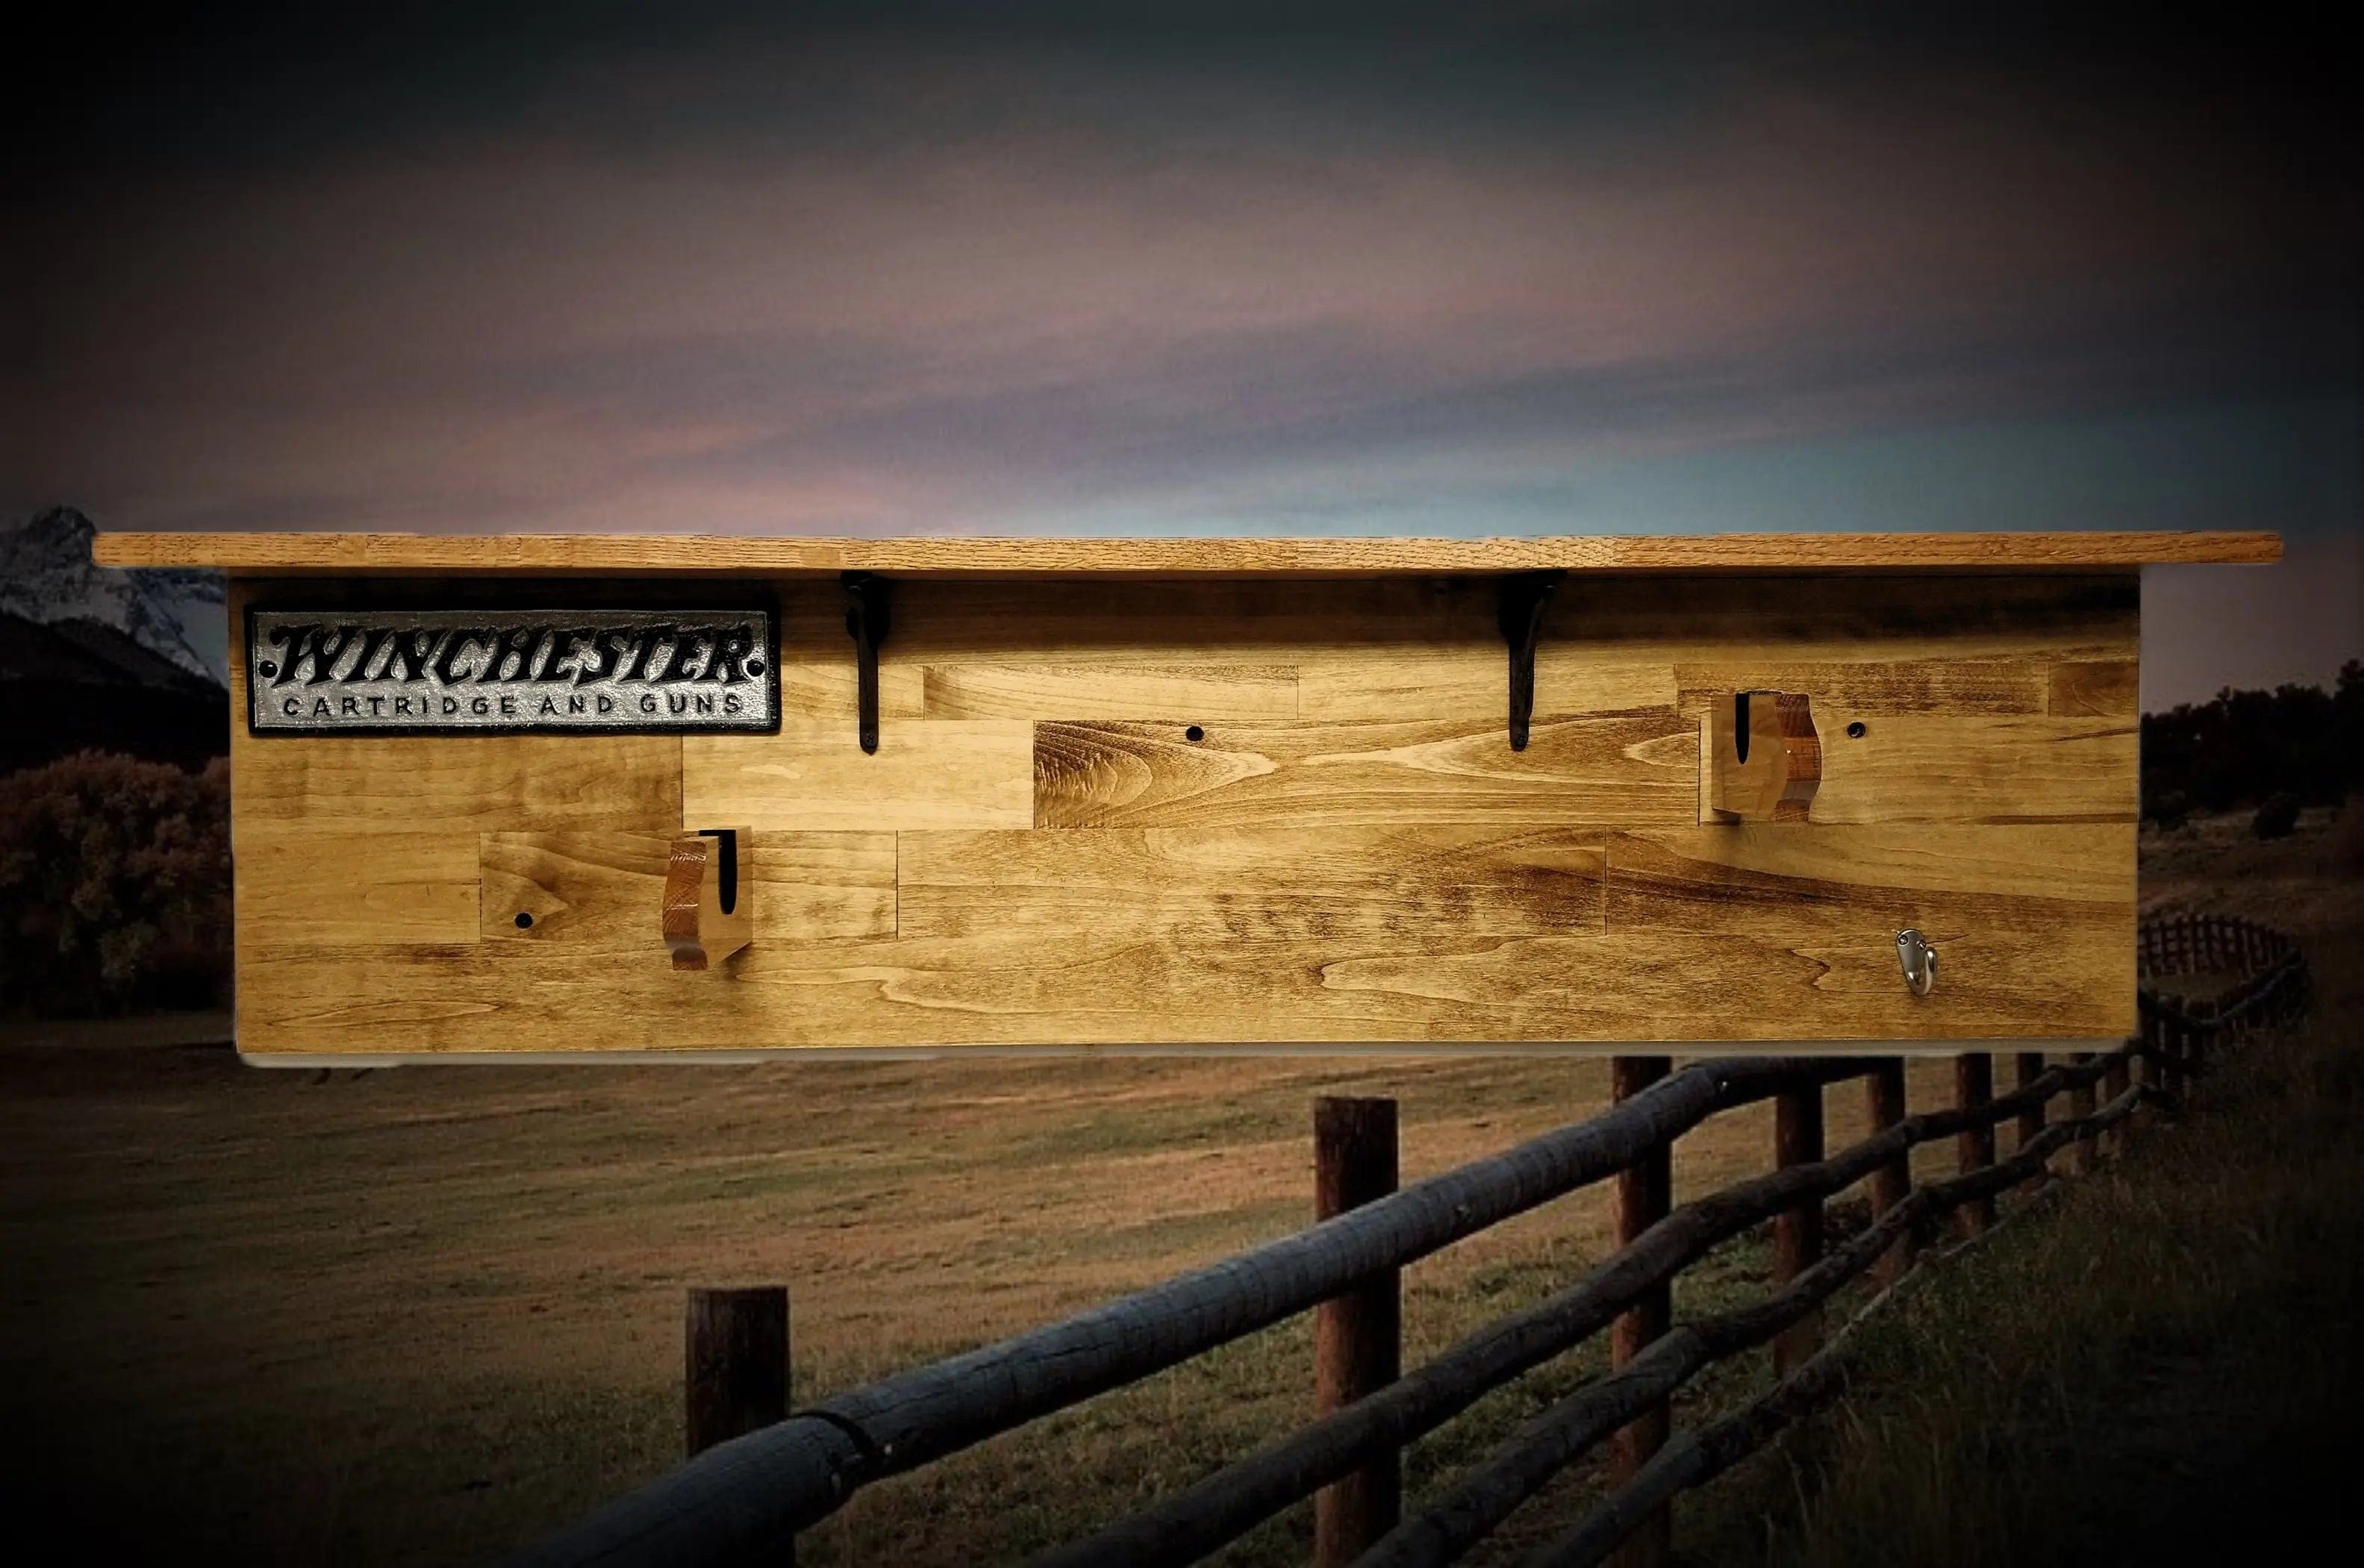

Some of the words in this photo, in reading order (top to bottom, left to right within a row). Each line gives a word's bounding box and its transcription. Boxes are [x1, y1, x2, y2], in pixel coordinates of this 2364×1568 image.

[269, 622, 752, 688] WINCHESTER
[284, 696, 516, 717] CARTRIDGE
[540, 693, 613, 715] AND
[640, 693, 743, 714] GUNS
